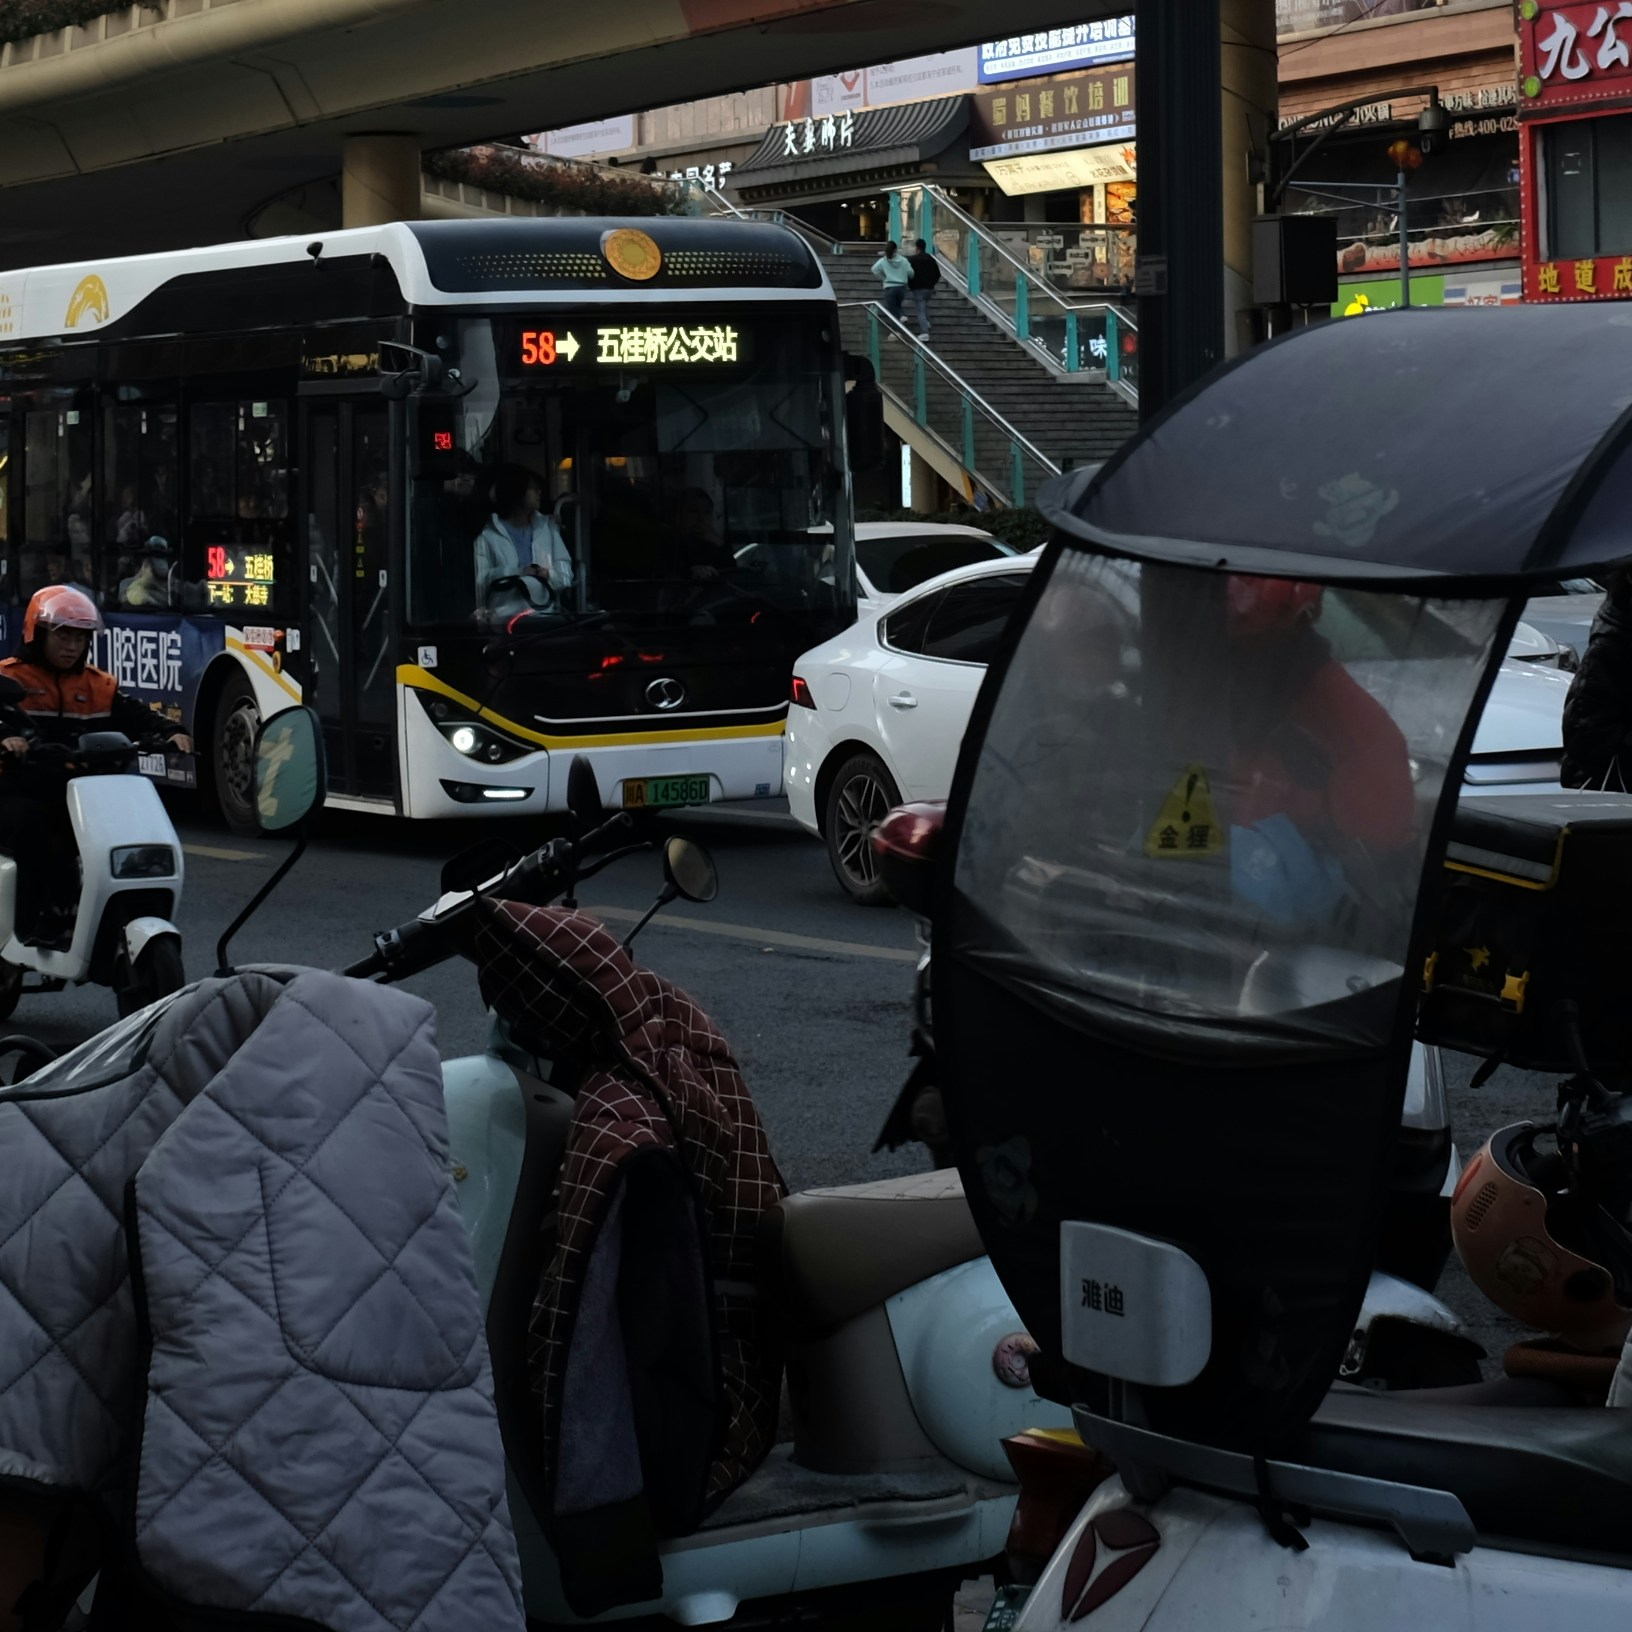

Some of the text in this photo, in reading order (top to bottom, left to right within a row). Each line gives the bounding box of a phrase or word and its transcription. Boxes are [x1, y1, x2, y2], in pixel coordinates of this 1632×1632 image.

[783, 109, 855, 156] 夫妻肺片
[521, 325, 738, 364] 58 五桂桥公交站
[208, 546, 274, 580] 58 五桂桥
[86, 626, 184, 693] 口腔医院
[652, 780, 709, 802] 14586D
[1080, 1278, 1125, 1318] 雅迪
